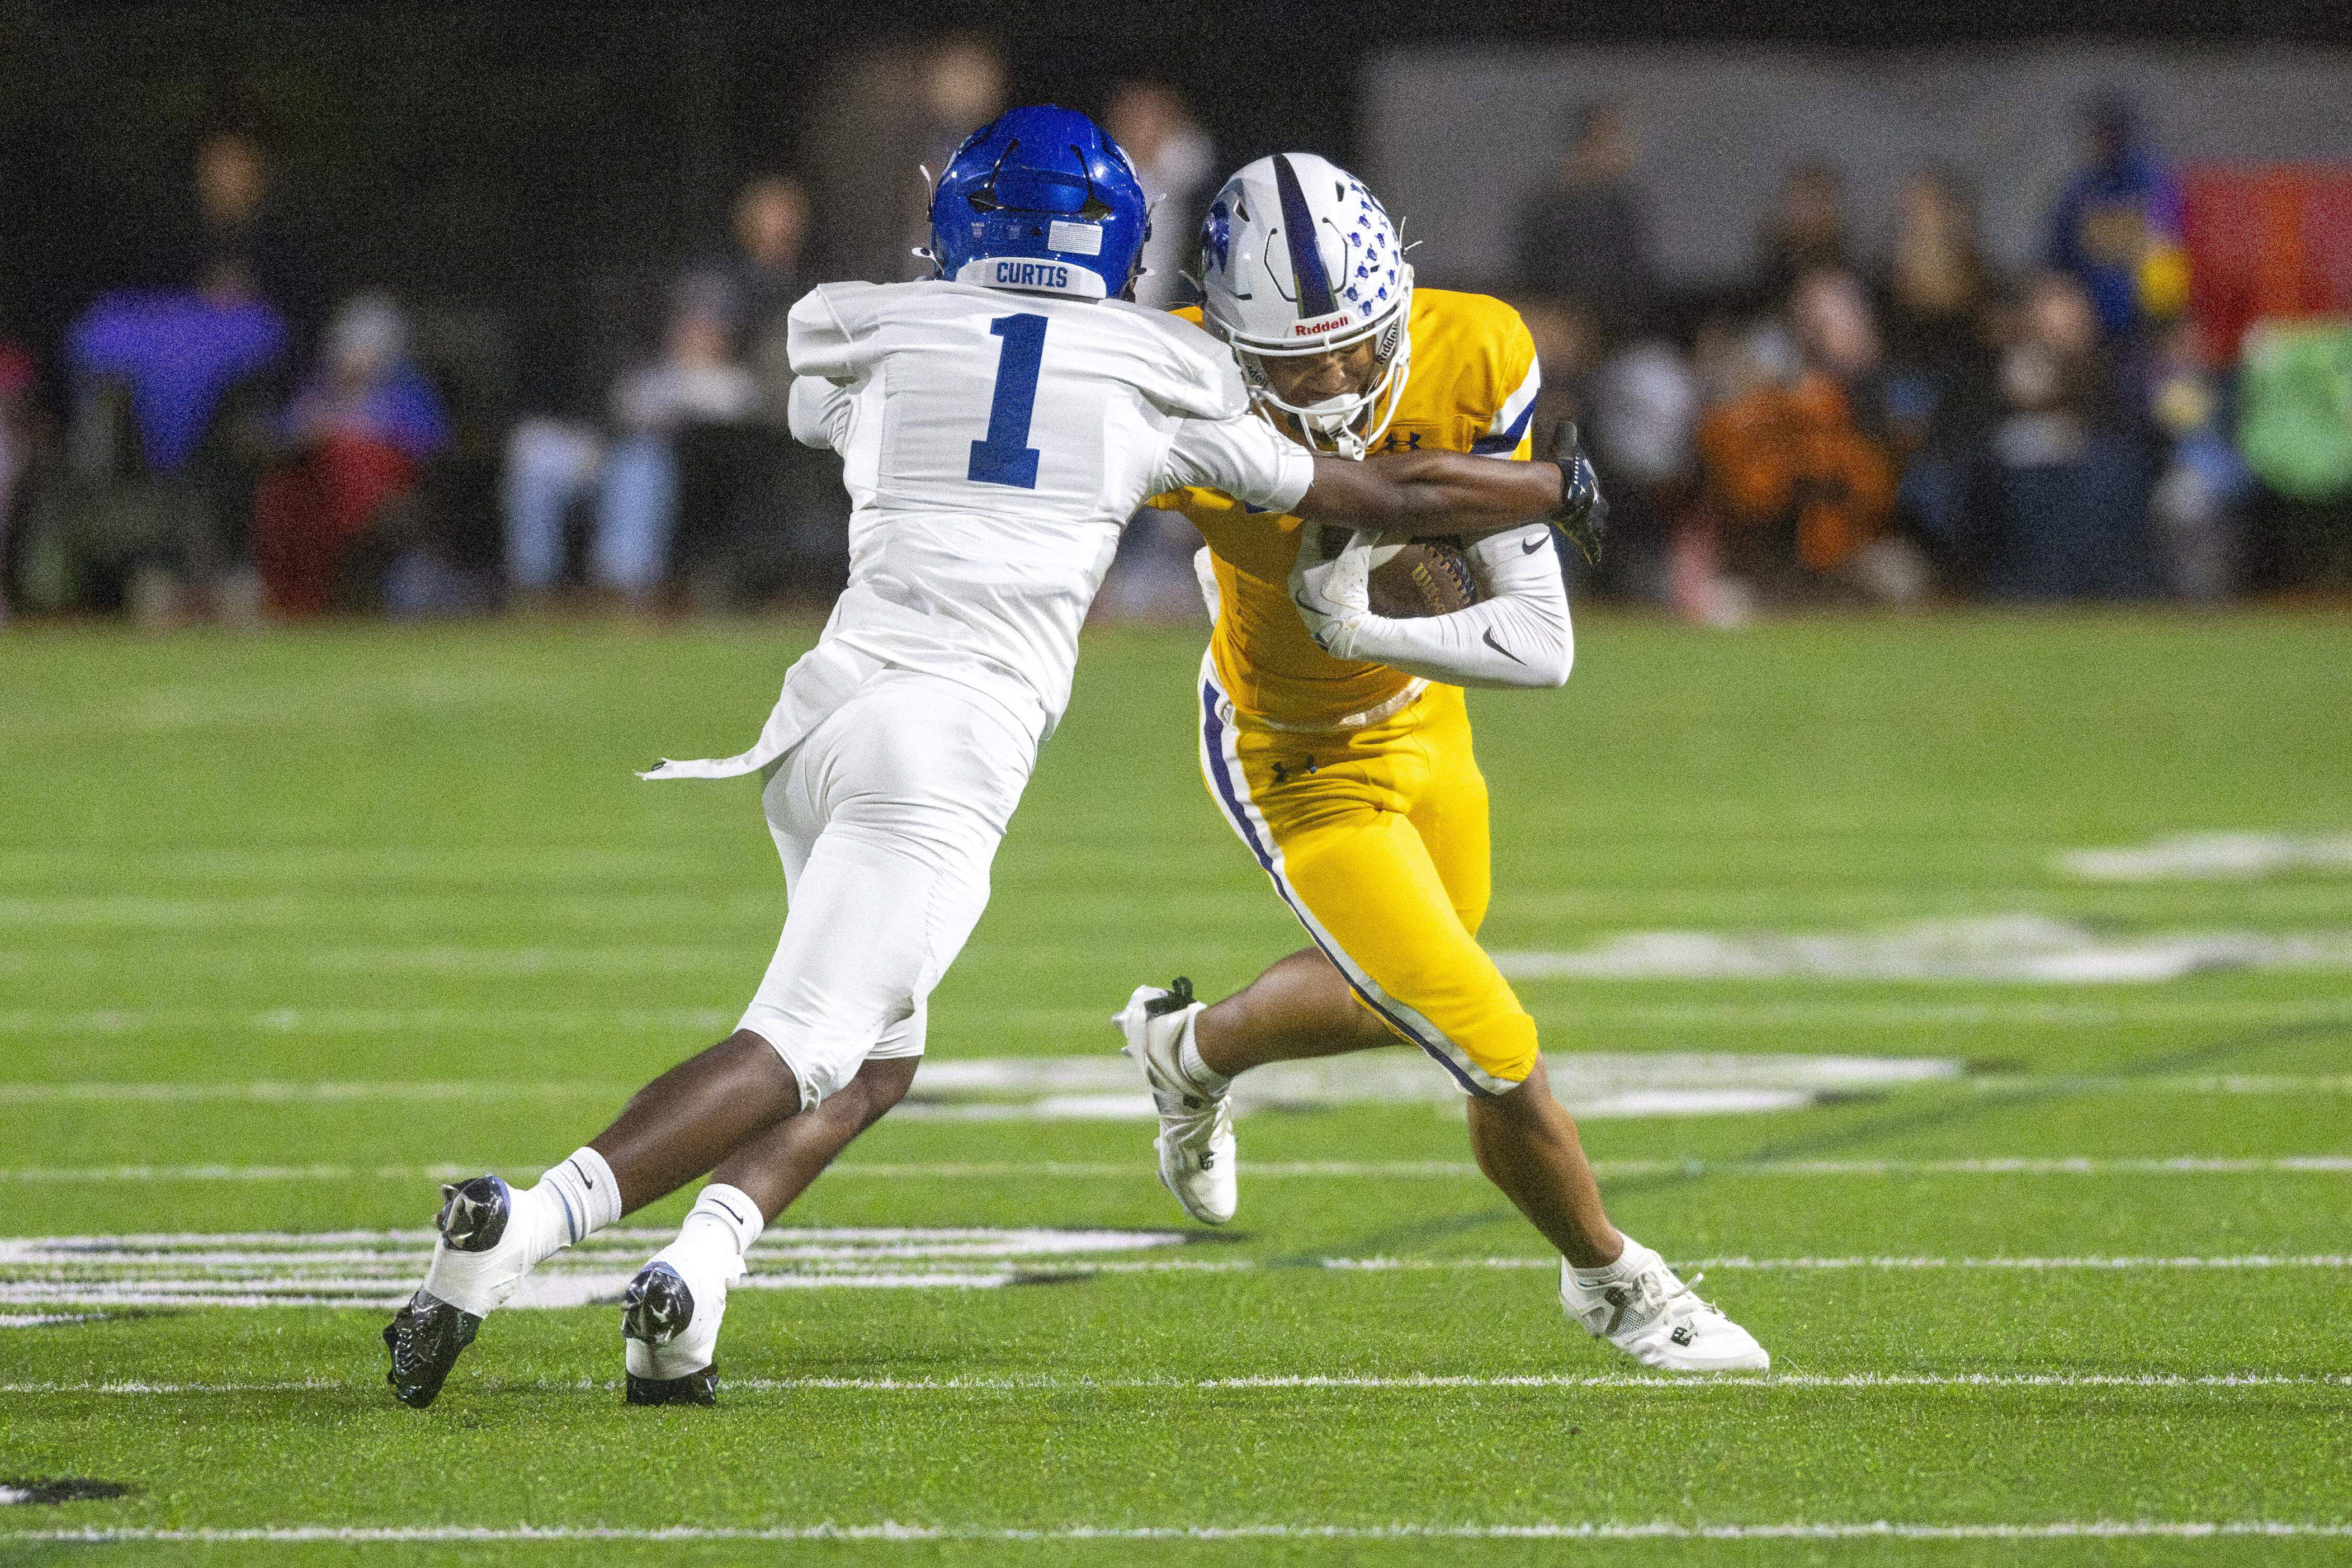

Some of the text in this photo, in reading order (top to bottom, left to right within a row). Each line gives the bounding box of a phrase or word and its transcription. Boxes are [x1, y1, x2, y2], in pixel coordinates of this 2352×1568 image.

[996, 262, 1068, 287] CURTIS
[1295, 316, 1348, 336] Riddell
[967, 313, 1049, 489] 1
